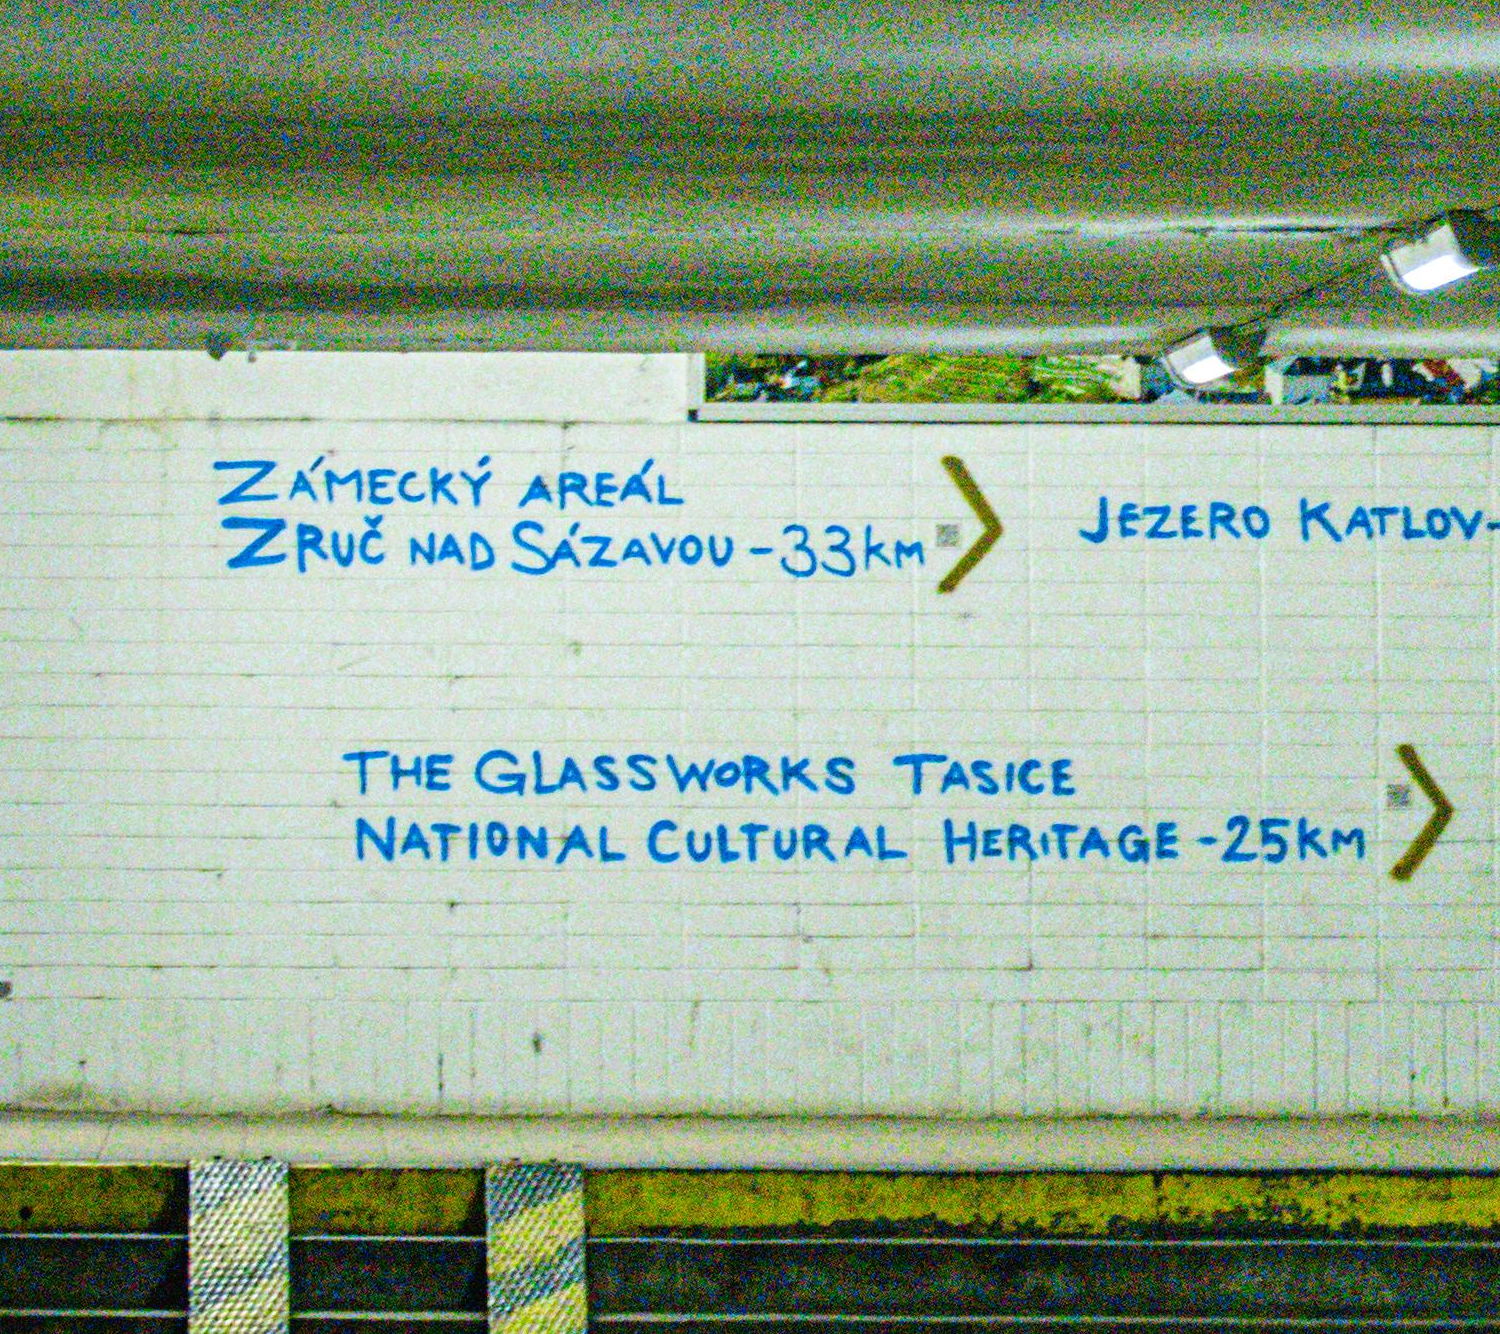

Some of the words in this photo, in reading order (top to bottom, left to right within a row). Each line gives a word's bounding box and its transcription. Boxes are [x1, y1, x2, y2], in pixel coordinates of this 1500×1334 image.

[213, 455, 491, 506] ZÁMECKÝ
[519, 458, 684, 508] AREÁL
[1079, 496, 1271, 543] JEZERO
[221, 515, 385, 573] ZRUČ
[409, 532, 496, 571] NAD
[511, 519, 734, 577] SÁZAVOU
[342, 750, 453, 794] THE
[474, 749, 855, 797] GLASSWORKS
[892, 753, 1075, 797] TASICE
[355, 817, 627, 865] NATIONAL
[646, 819, 907, 865] CULTURAL
[943, 818, 1179, 864] HERITAGE
